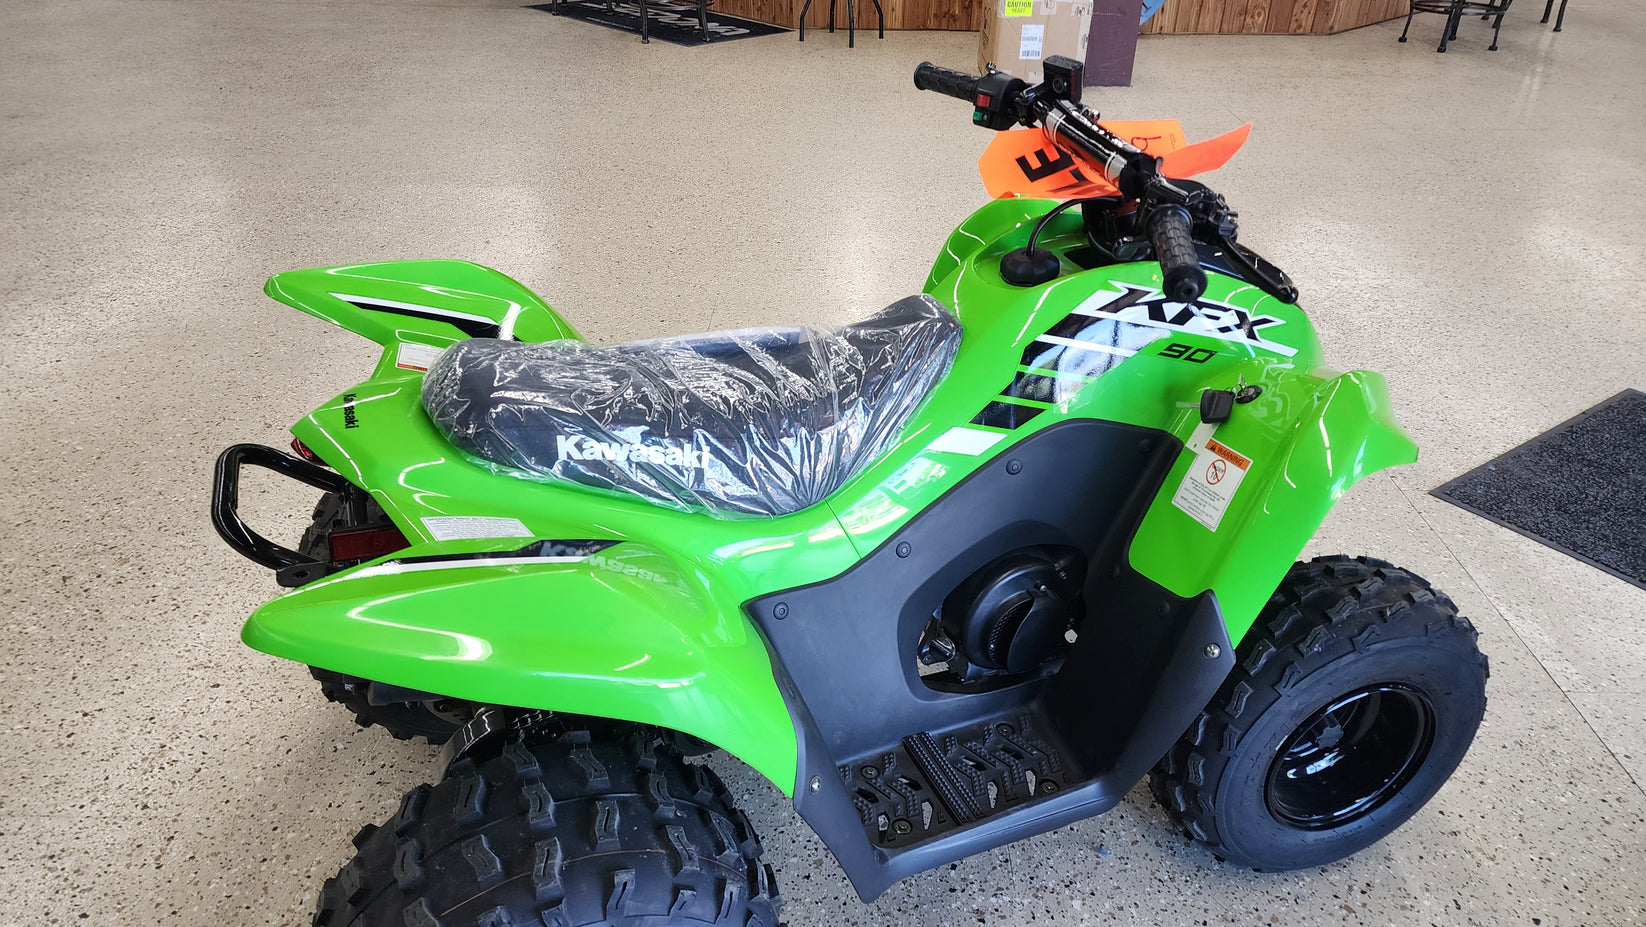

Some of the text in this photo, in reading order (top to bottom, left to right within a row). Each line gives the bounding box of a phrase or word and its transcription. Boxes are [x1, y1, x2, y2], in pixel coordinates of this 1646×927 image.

[1157, 343, 1218, 363] 90
[343, 393, 359, 429] Kaasaki
[556, 435, 711, 469] Kawasaki
[1217, 446, 1245, 467] WARNING
